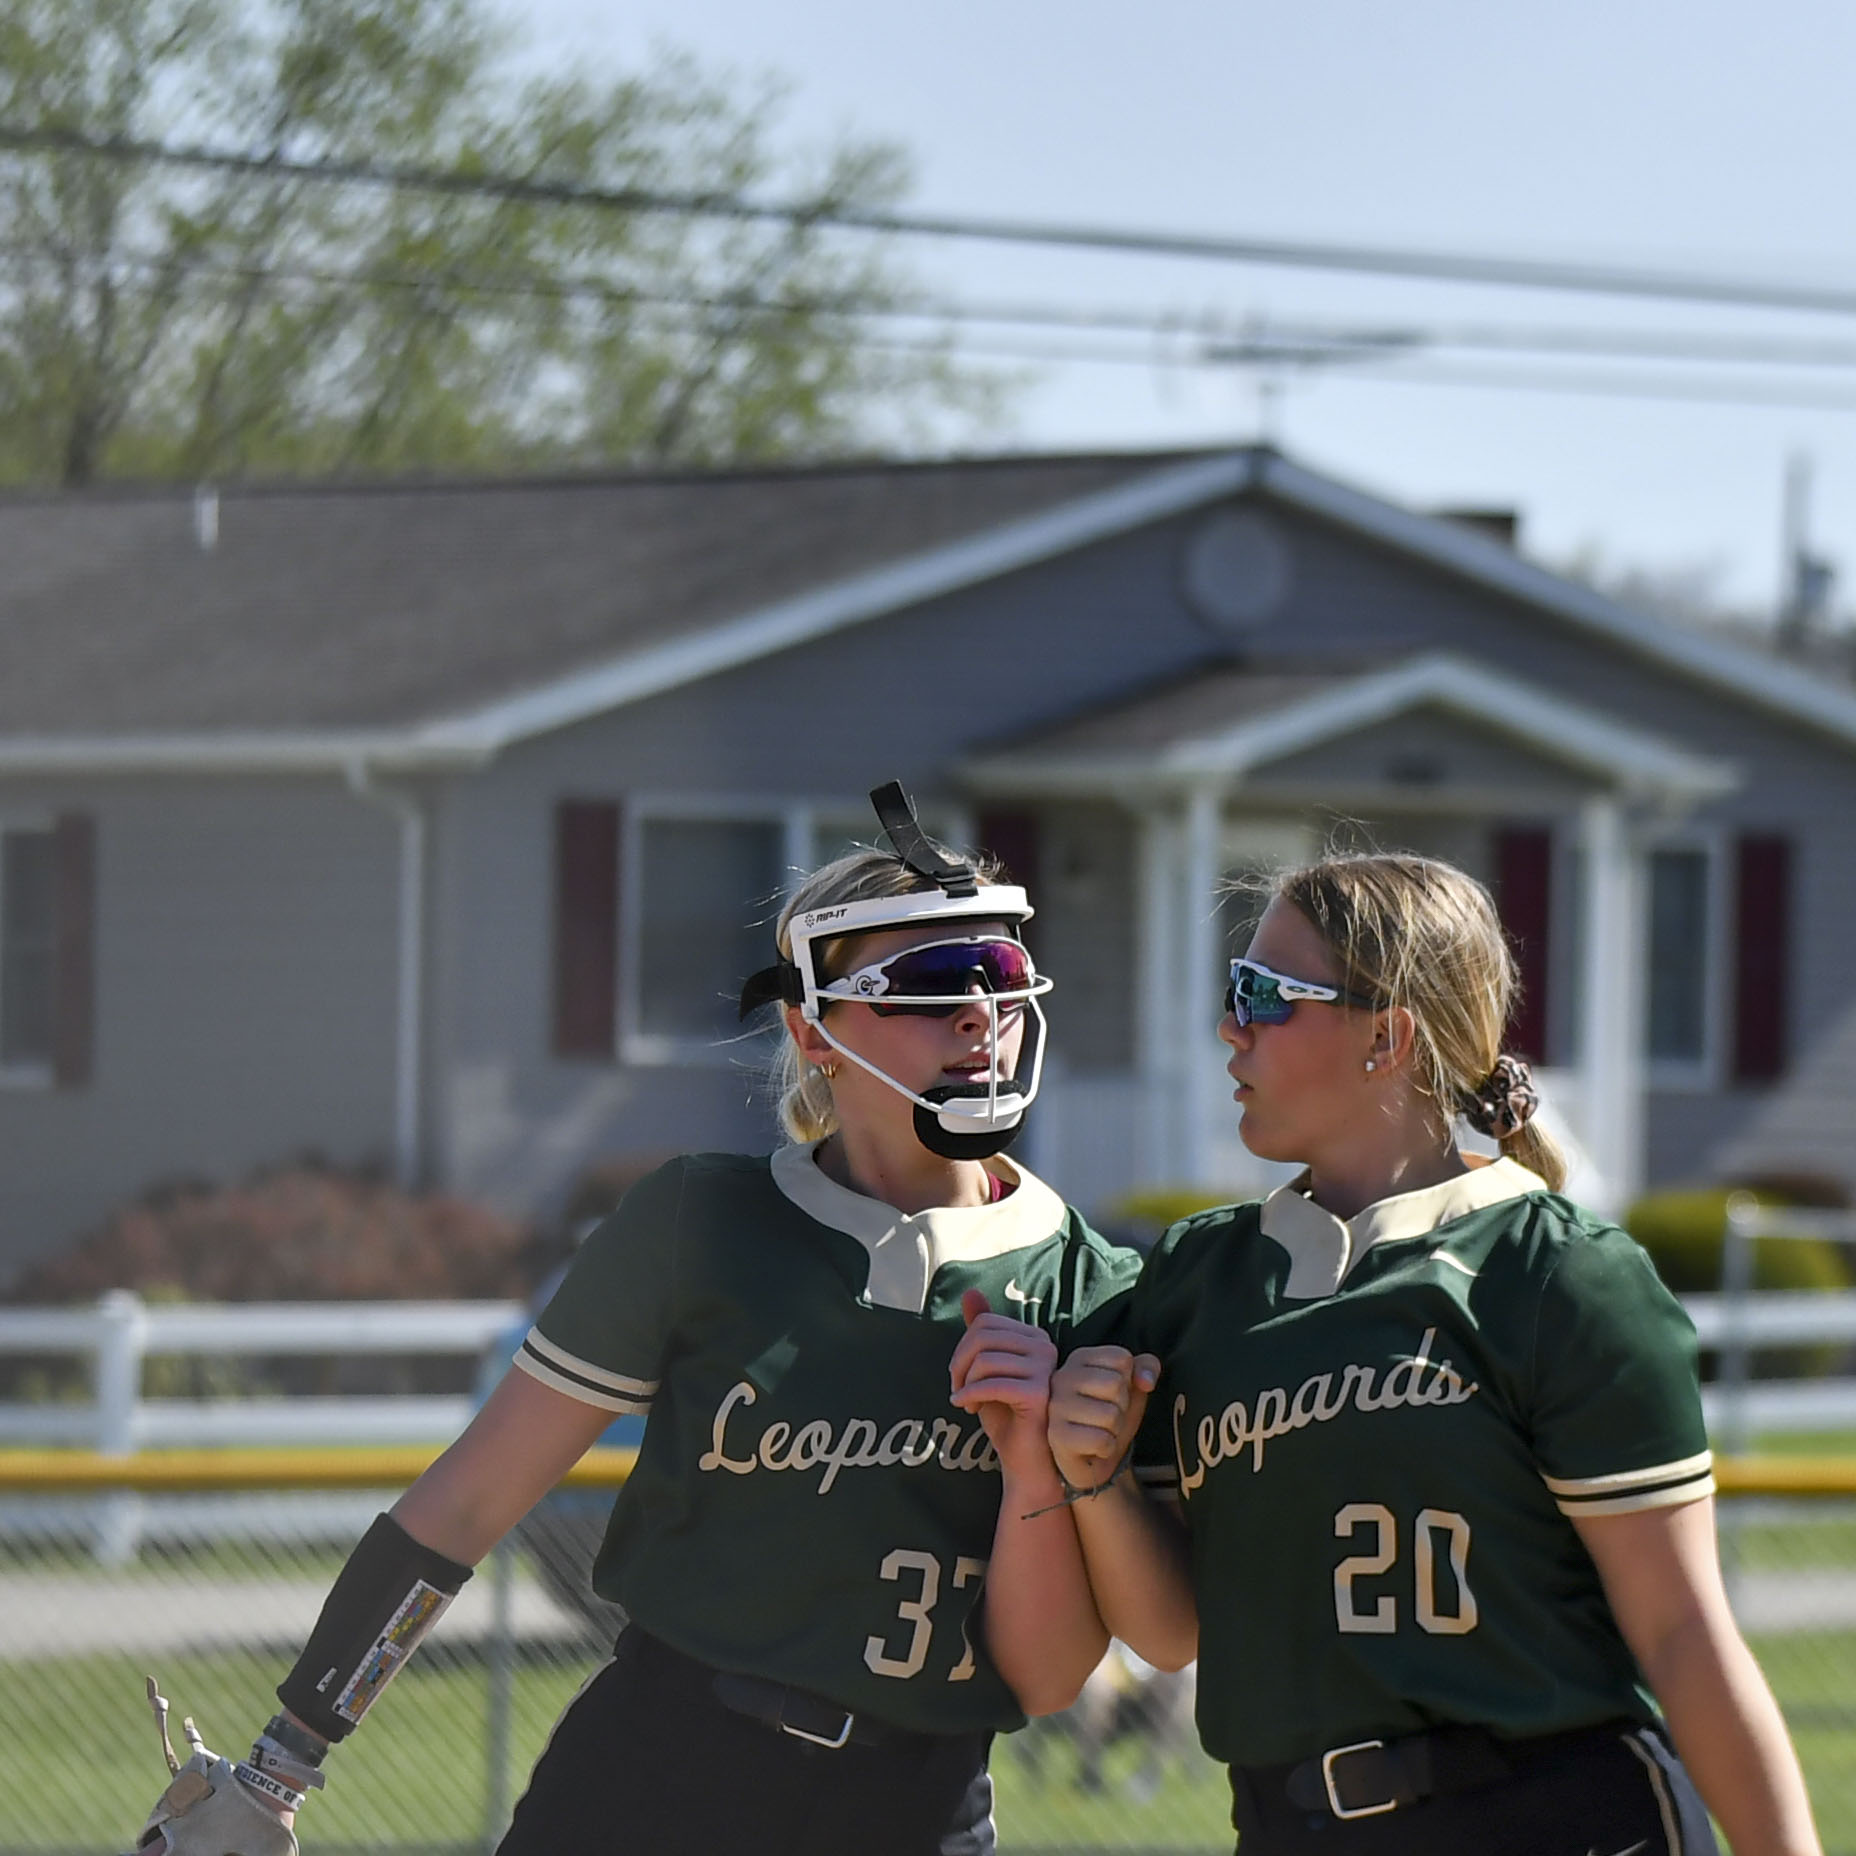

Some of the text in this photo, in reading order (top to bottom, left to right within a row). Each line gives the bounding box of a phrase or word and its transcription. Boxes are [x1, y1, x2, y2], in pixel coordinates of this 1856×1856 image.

[816, 908, 848, 924] RIP-IT
[698, 1382, 1002, 1495] Leopar
[1173, 1327, 1479, 1500] Leopards
[1334, 1503, 1478, 1634] 20
